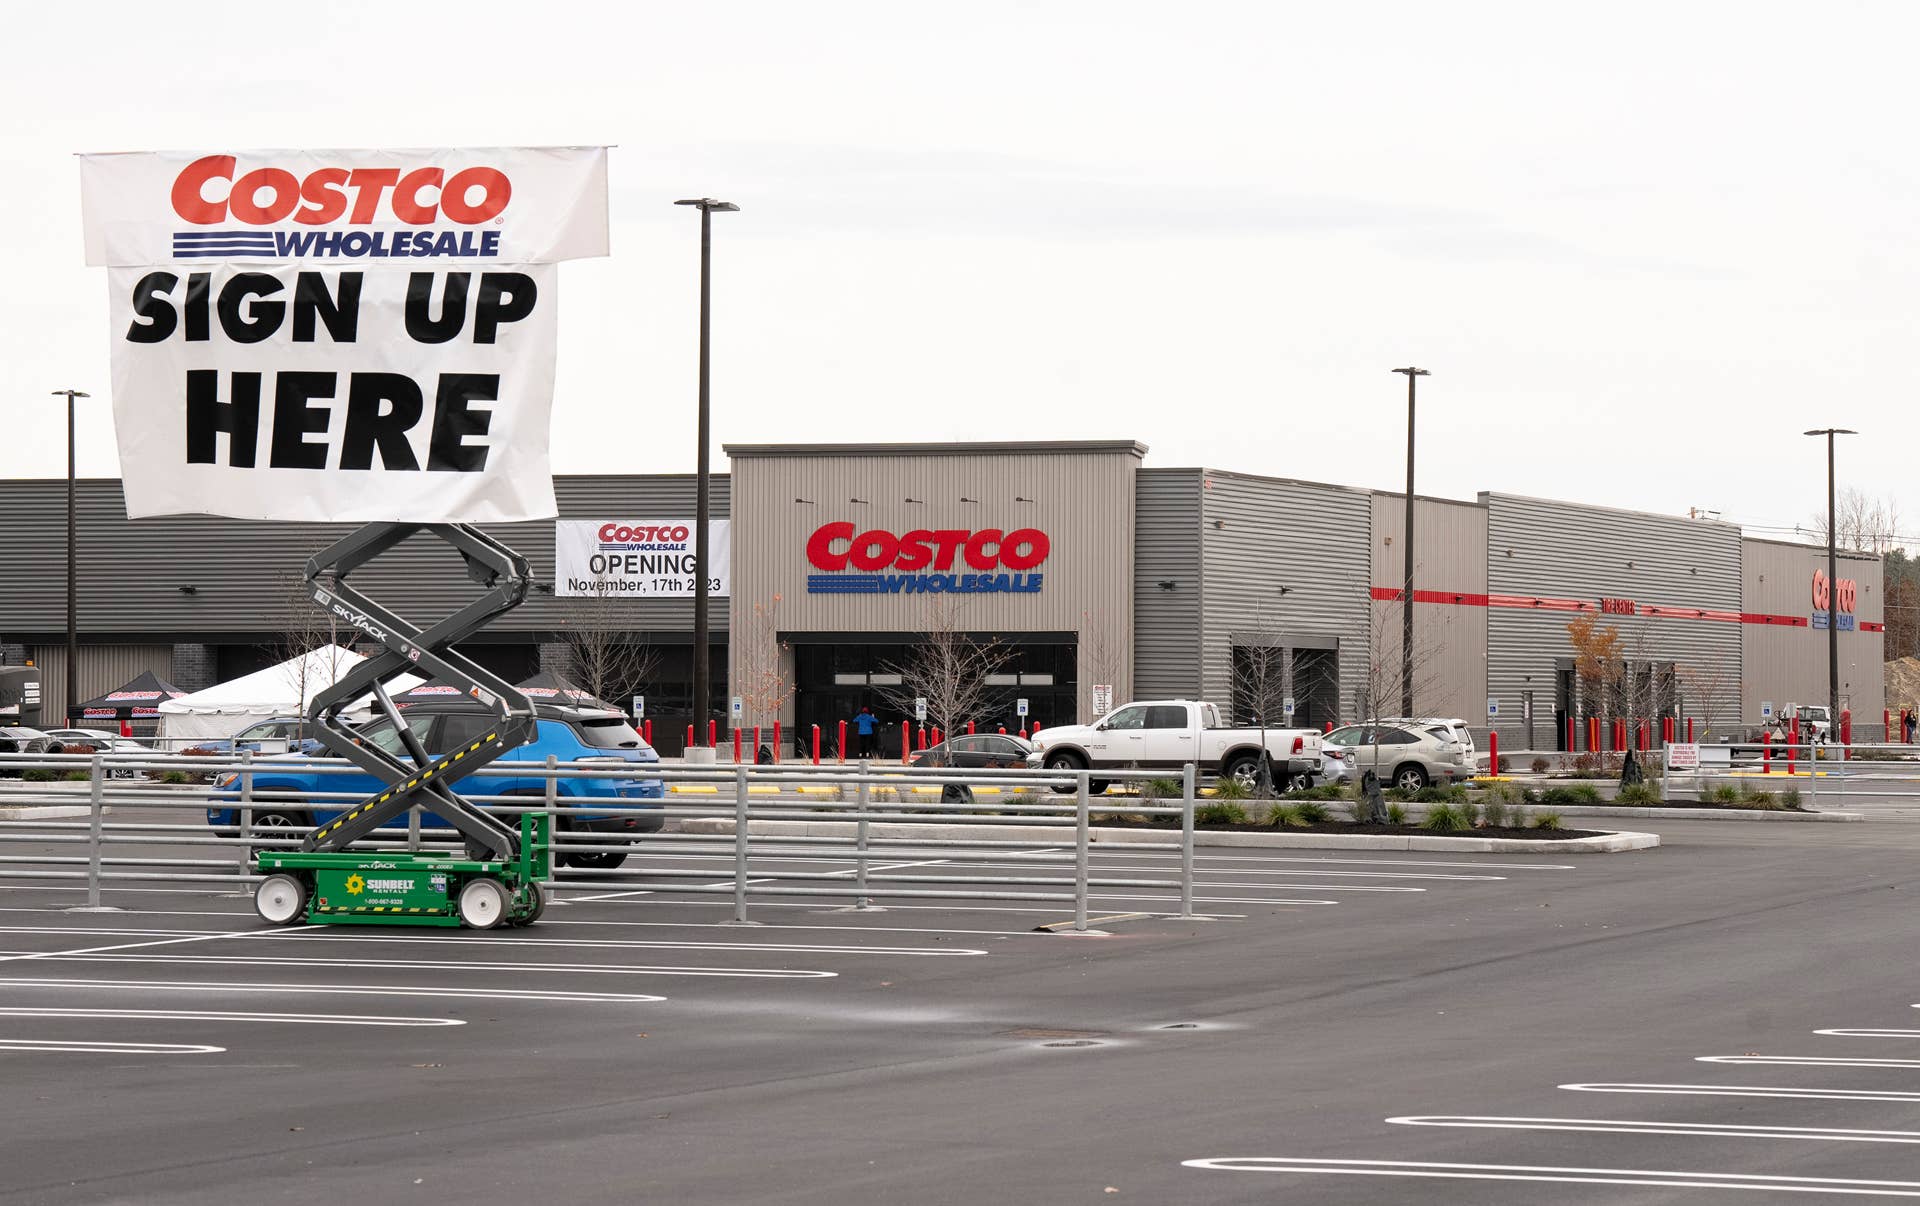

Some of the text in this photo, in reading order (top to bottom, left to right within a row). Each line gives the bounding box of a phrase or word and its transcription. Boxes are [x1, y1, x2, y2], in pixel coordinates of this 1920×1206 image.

[171, 155, 512, 226] COSTCO
[273, 230, 501, 257] WHOLESALE
[126, 271, 538, 344] SIGN UP
[186, 369, 501, 473] HERE
[598, 523, 689, 543] COSTCO
[806, 521, 1051, 571] COSTCO
[626, 543, 687, 551] WHOLESALE
[589, 554, 697, 575] OPENING
[568, 578, 721, 593] November, 17th 223
[876, 573, 1043, 593] WHOLESALE
[1812, 568, 1857, 613] COTCO
[332, 604, 389, 643] SKYJACK
[367, 879, 414, 890] SUNBELT
